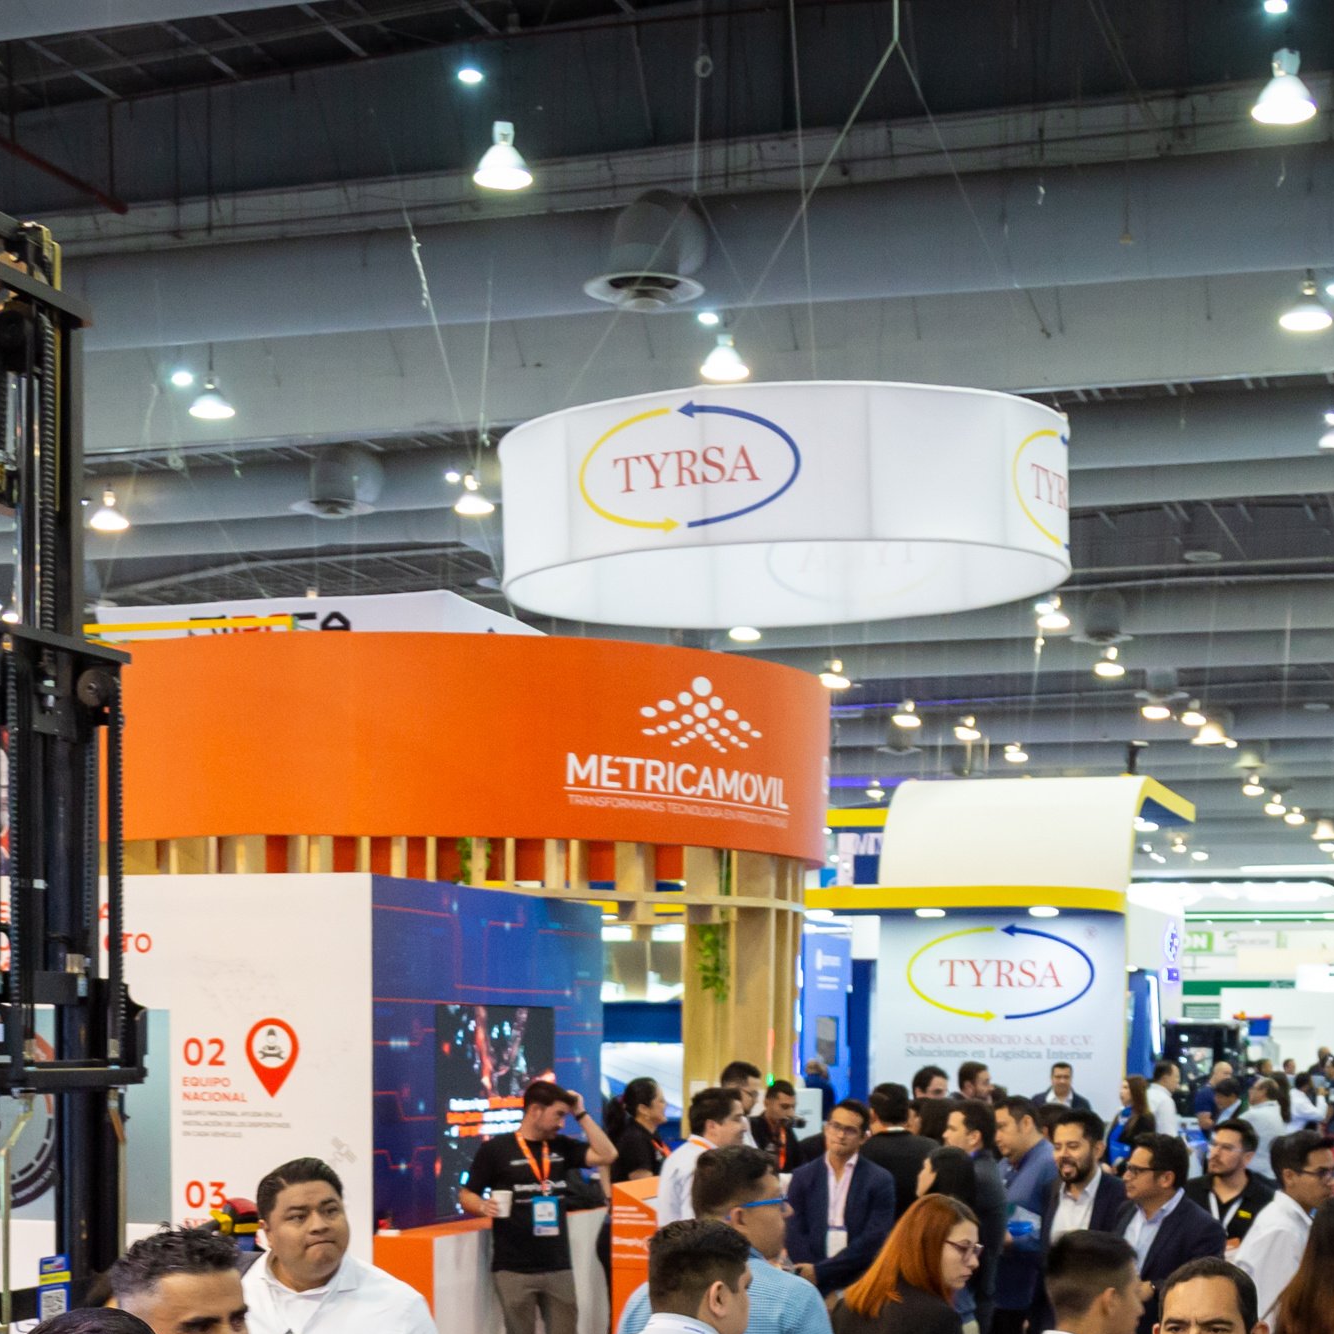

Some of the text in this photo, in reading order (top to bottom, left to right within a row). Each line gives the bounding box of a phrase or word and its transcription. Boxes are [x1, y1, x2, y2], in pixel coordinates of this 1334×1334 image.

[613, 445, 762, 494] TYRSA
[939, 959, 1063, 988] TYRSA
[905, 1033, 945, 1044] TYRSA
[947, 1033, 1021, 1045] CONSORCIO
[1051, 1034, 1069, 1045] DE
[183, 1037, 226, 1066] 02
[905, 1048, 968, 1059] Soluciones
[971, 1050, 986, 1059] en
[1047, 1049, 1093, 1060] Interior
[182, 1077, 231, 1087] EQUIPO
[182, 1091, 247, 1102] NACIONAL
[185, 1180, 227, 1209] 03
